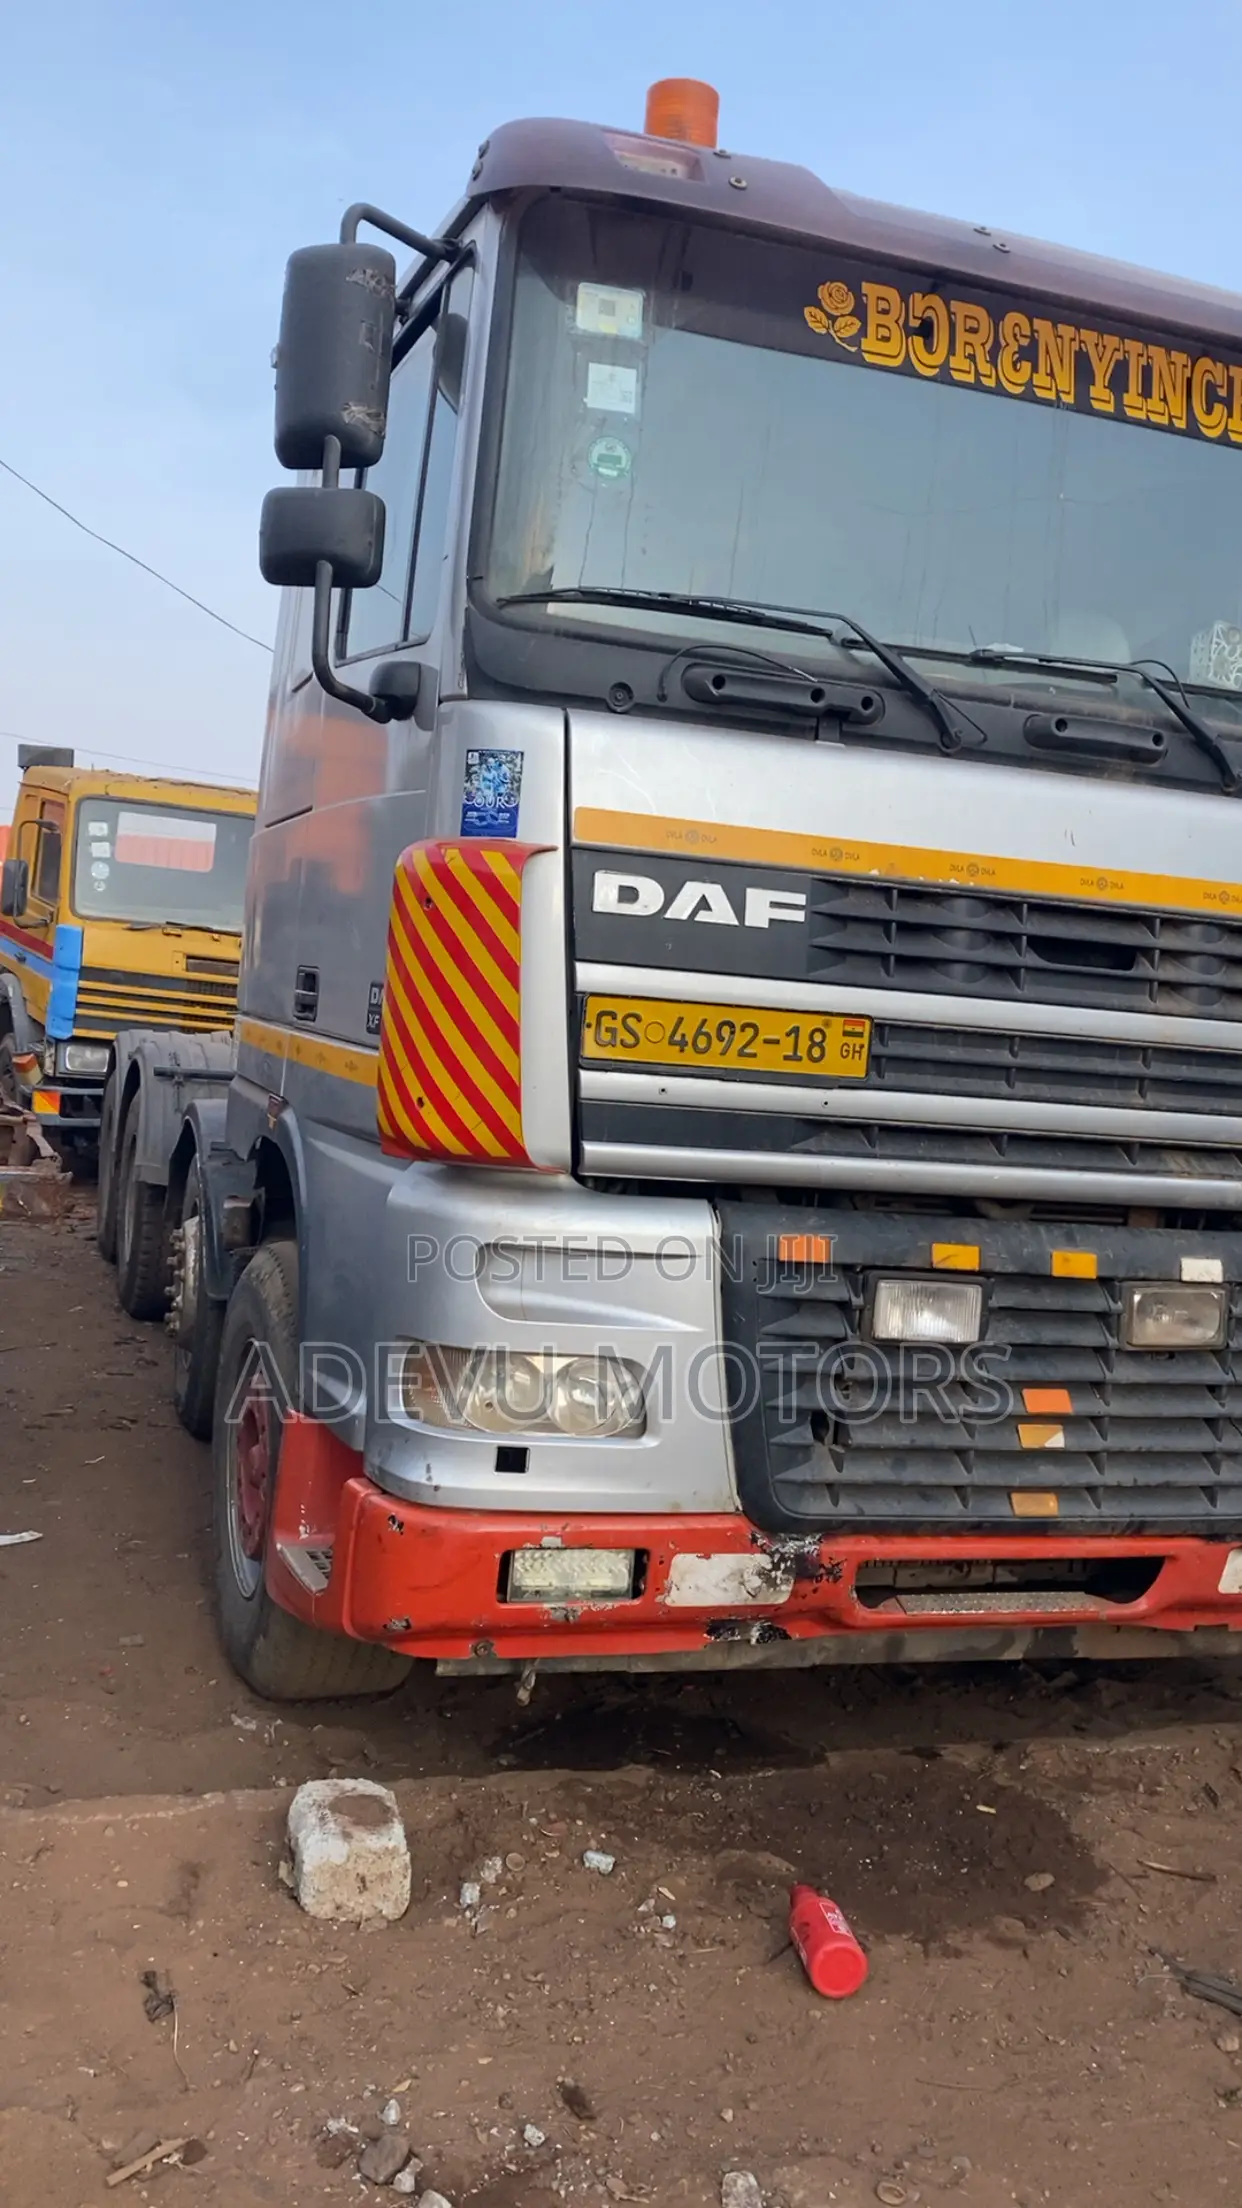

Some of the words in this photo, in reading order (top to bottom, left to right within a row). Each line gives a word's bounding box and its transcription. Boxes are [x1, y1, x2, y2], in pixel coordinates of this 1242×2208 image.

[592, 870, 807, 929] DAF
[594, 1010, 642, 1049] GS
[668, 1016, 827, 1063] 4692-18
[839, 1041, 864, 1061] GH
